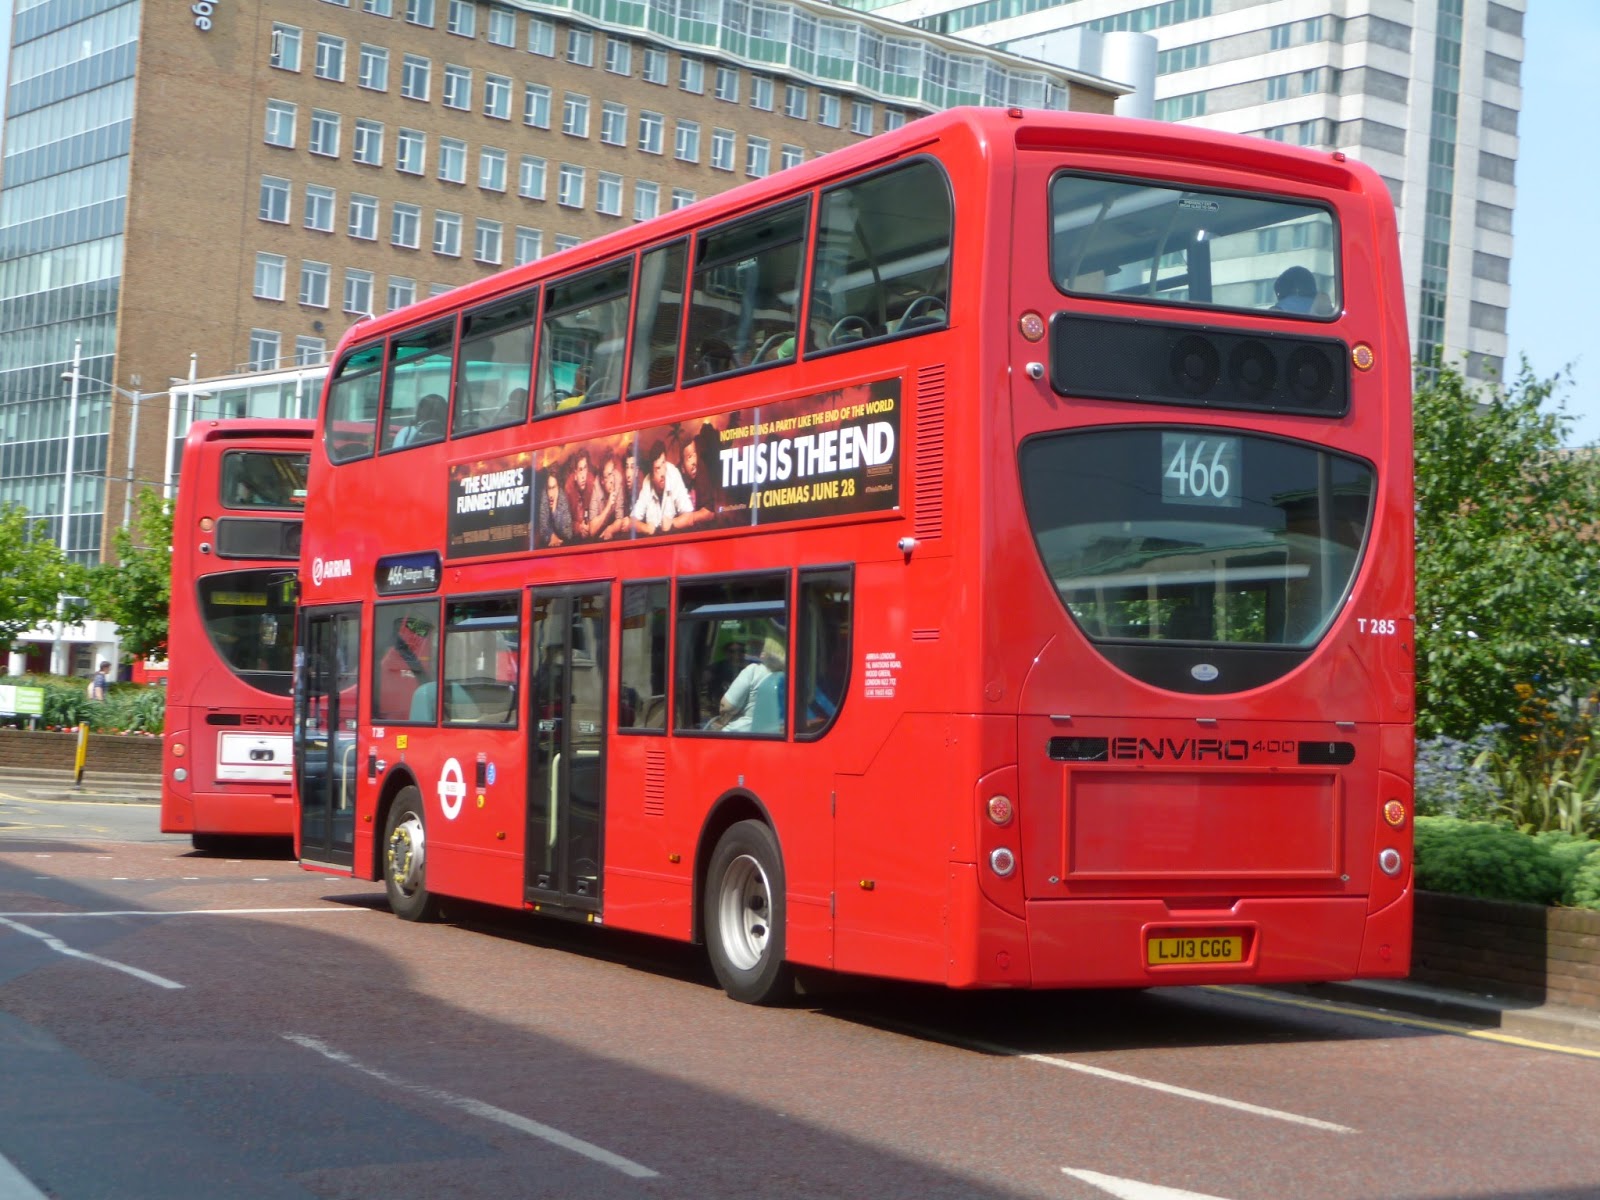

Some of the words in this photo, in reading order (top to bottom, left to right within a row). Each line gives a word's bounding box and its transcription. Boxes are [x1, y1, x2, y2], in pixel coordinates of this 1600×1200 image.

[192, 0, 219, 30] ge
[720, 426, 749, 441] NOTHING
[769, 421, 775, 433] A
[776, 417, 797, 432] PARTY
[798, 414, 811, 428] LIKE
[812, 412, 824, 424] THE
[825, 409, 839, 422] END
[840, 406, 851, 419] OF
[851, 404, 865, 417] THE
[866, 399, 894, 415] WORLD
[719, 443, 768, 488] THIS
[770, 439, 792, 481] IS
[794, 430, 838, 477] THE
[839, 421, 895, 470] END
[1164, 440, 1229, 498] 466
[456, 490, 497, 514] FUNNIEST
[749, 492, 762, 509] AT
[763, 484, 810, 508] CINEMAS
[811, 480, 839, 502] JUNE
[841, 478, 855, 498] 28
[323, 559, 352, 579] ARRIVA
[387, 565, 403, 586] 466
[1357, 618, 1367, 633] T
[1370, 618, 1395, 635] 285
[1112, 738, 1249, 761] ENVIRO
[1252, 740, 1295, 753] 400
[1159, 940, 1195, 959] LJ13
[1200, 939, 1232, 958] CGG
